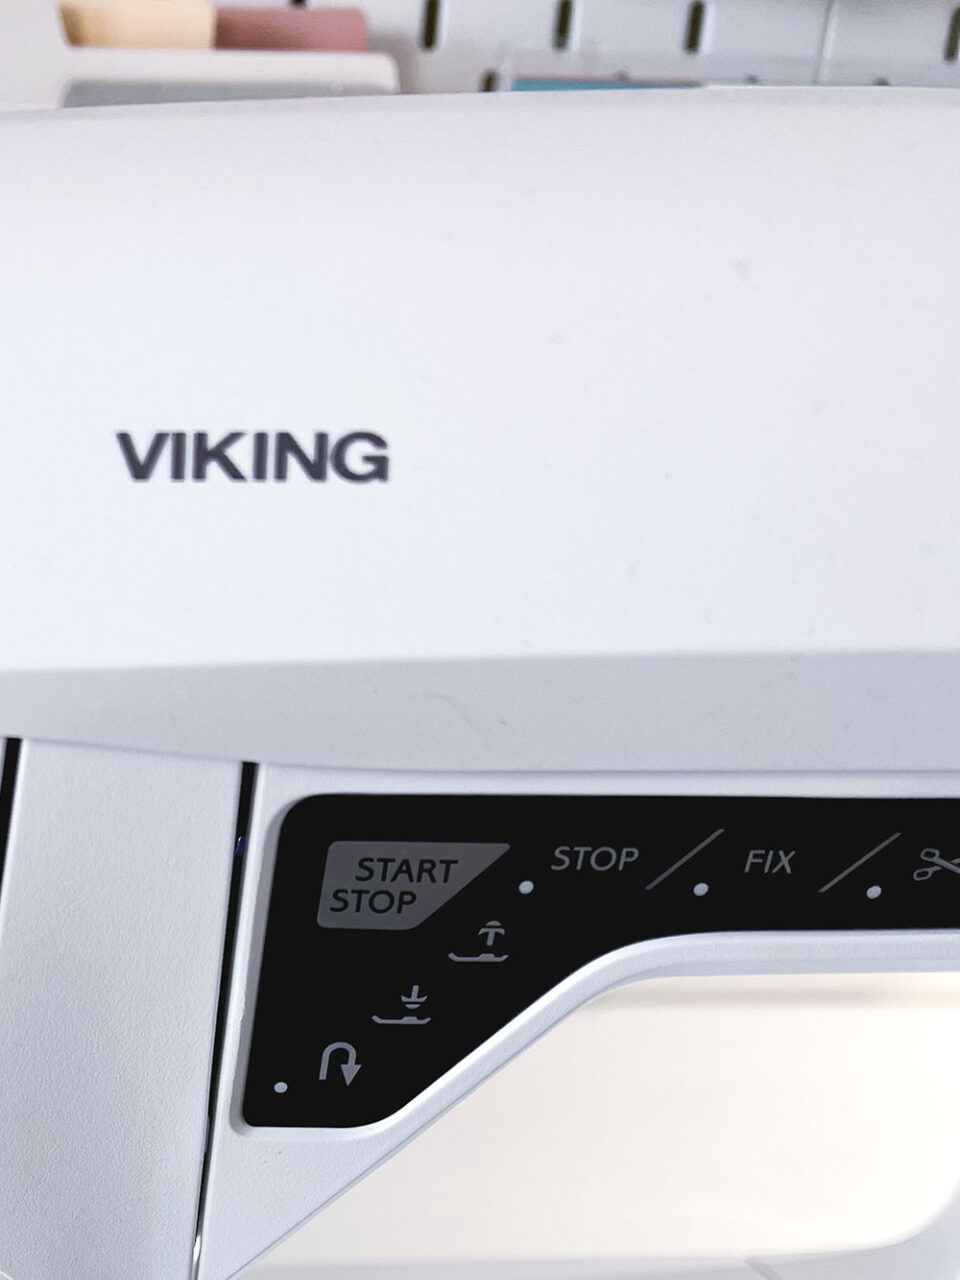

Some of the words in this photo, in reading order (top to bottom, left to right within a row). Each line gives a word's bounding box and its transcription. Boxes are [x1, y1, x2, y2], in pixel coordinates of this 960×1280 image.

[115, 430, 390, 483] VIKING
[354, 857, 459, 884] START
[550, 846, 640, 871] STOP
[744, 849, 796, 875] FIX
[329, 888, 418, 915] STOP
